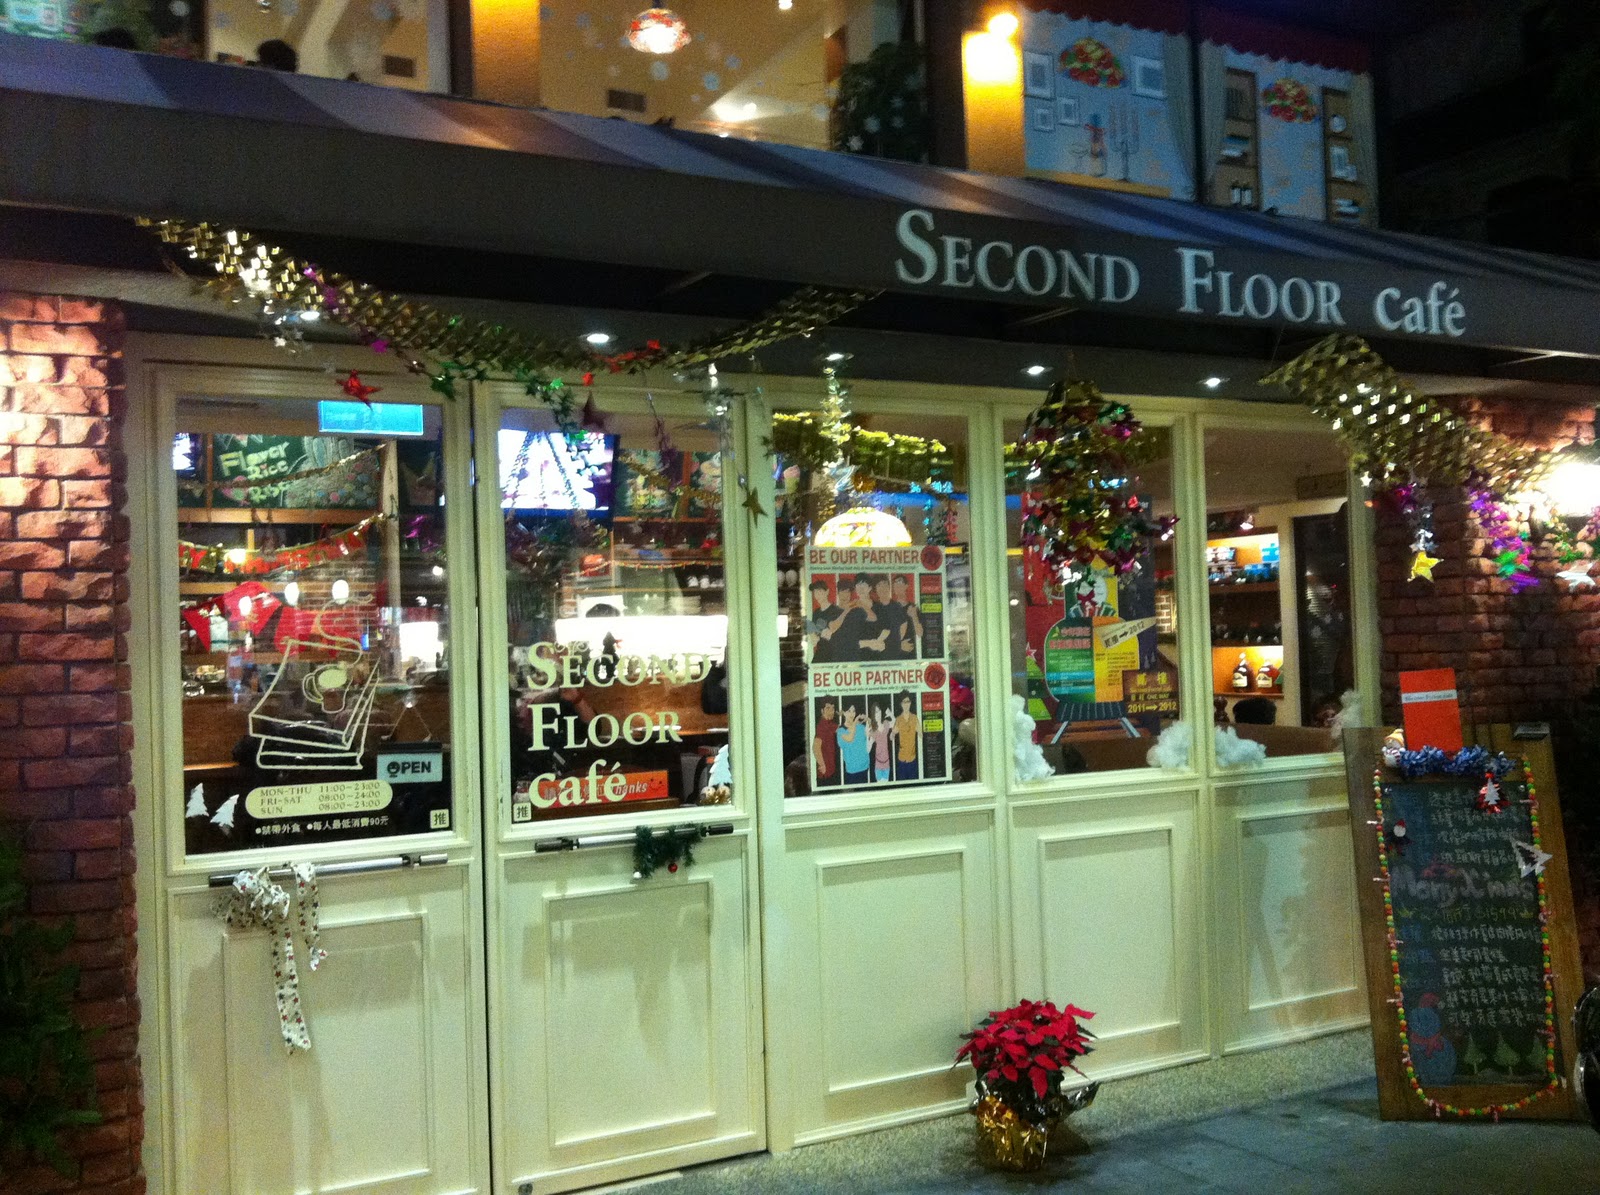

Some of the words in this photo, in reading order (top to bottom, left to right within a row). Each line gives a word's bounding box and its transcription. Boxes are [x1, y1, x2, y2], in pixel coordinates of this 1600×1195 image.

[895, 209, 1140, 302] SECOND
[1176, 247, 1346, 326] FLOOR
[809, 549, 827, 565] BE
[830, 549, 858, 565] OUR
[862, 549, 920, 565] PARTNER
[813, 672, 831, 688] BE
[834, 670, 862, 687] OUR
[866, 668, 924, 686] PARTNER
[528, 702, 683, 751] FLOOR
[387, 761, 431, 777] OPEN
